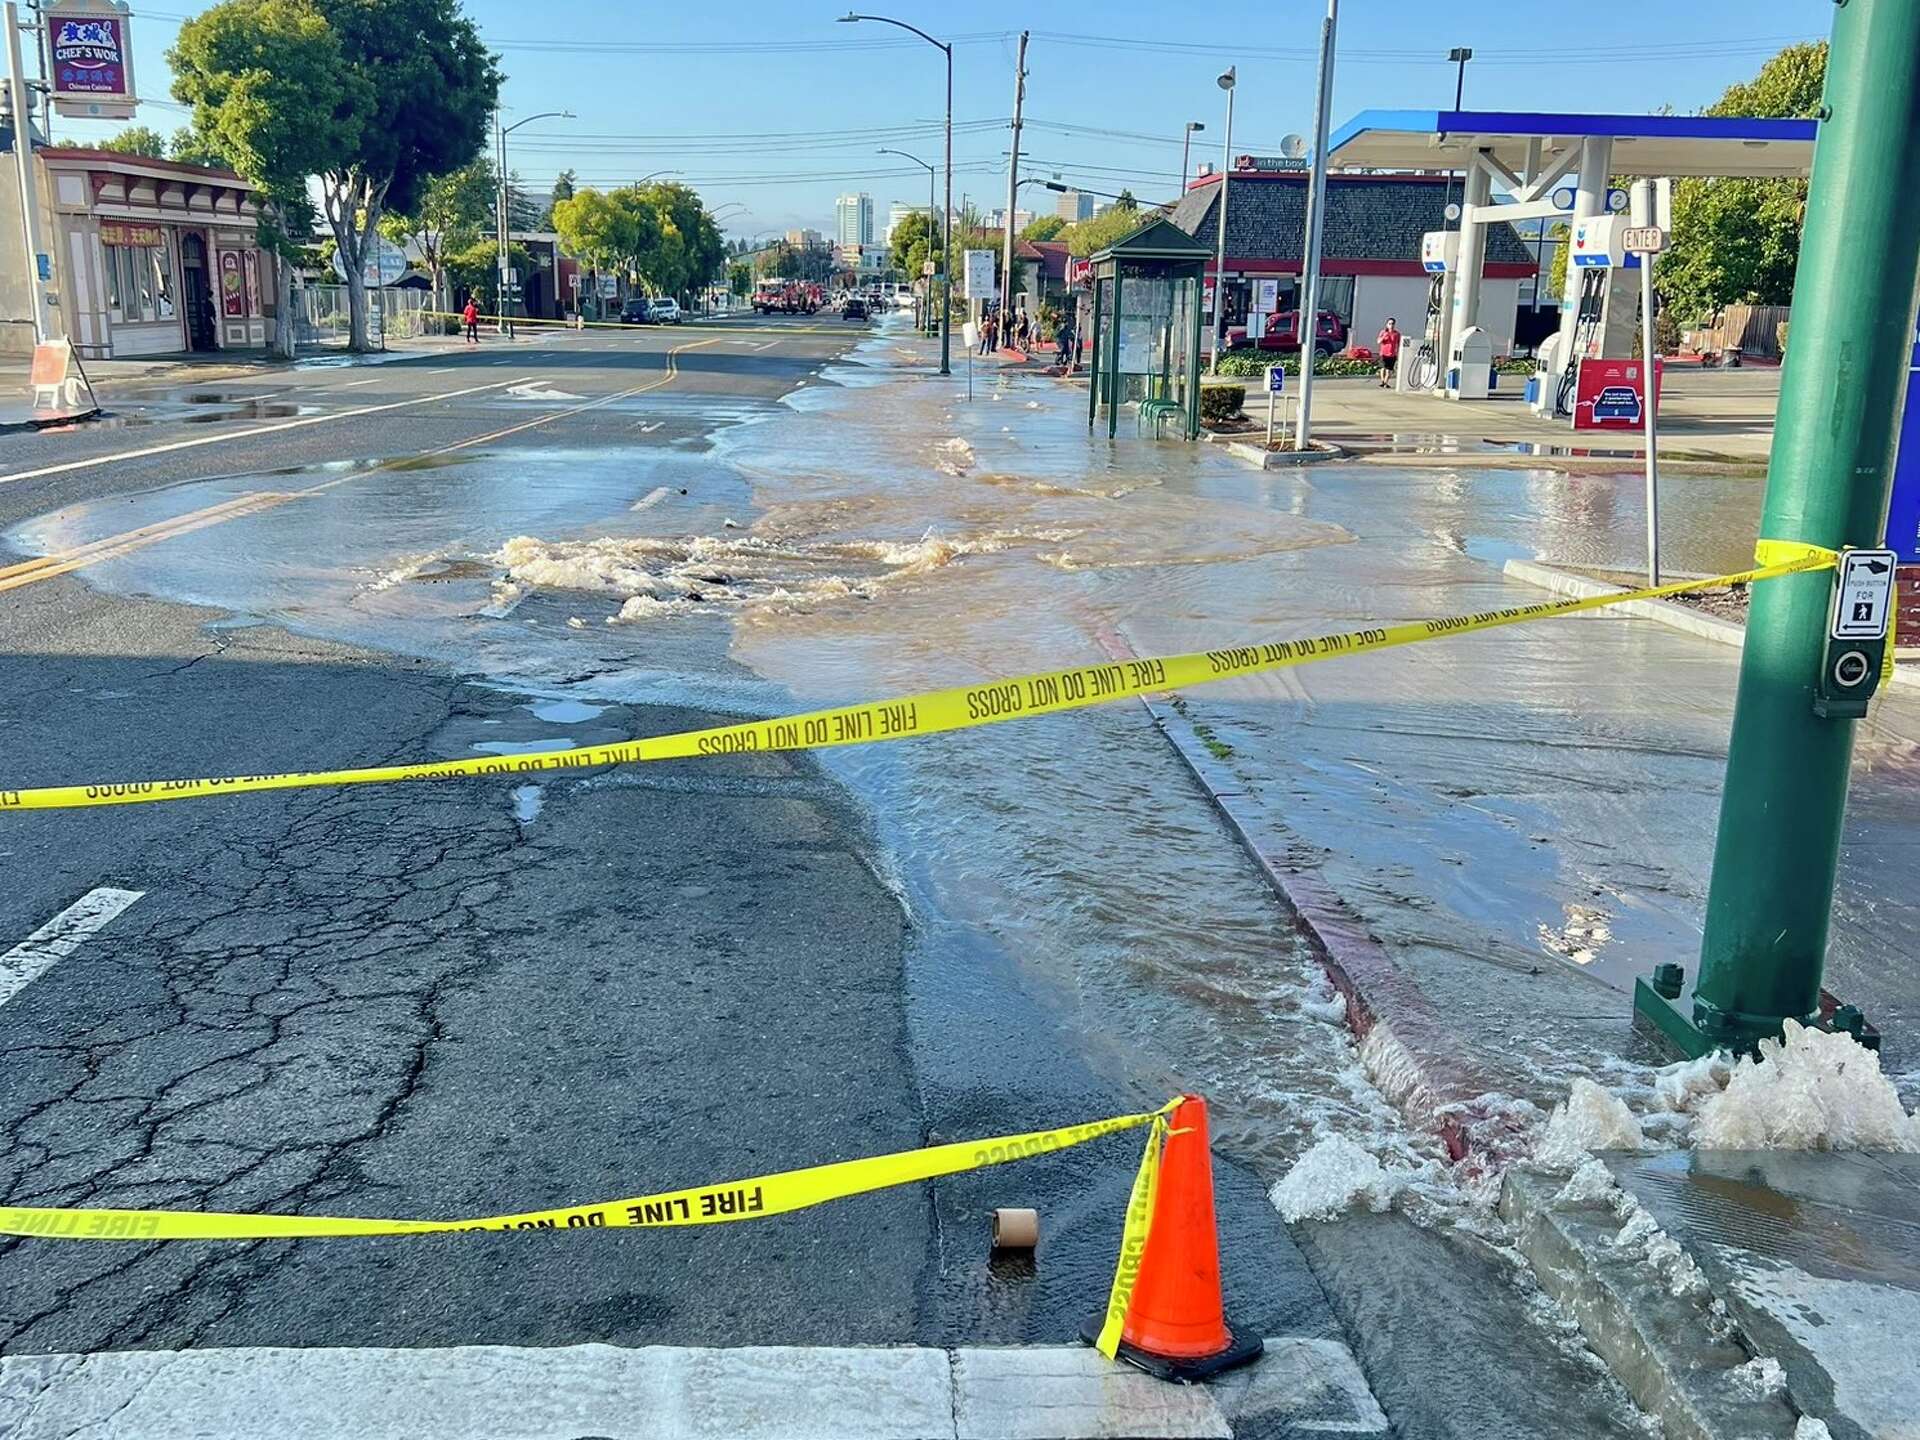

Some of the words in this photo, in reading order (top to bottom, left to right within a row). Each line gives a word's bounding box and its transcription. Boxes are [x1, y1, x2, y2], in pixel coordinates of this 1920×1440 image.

[56, 46, 92, 60] CHEF'S
[93, 48, 119, 62] WOK
[1614, 195, 1622, 205] 2
[1626, 230, 1658, 248] ENTER
[1856, 590, 1874, 600] FOR
[1206, 650, 1259, 673] CROSS
[1263, 642, 1293, 663] NOT
[1064, 672, 1086, 701] DO
[1088, 665, 1126, 697] LINE
[1127, 658, 1166, 689] FIRE
[967, 684, 1022, 719] CROSS
[1028, 678, 1059, 709] NOT
[804, 718, 828, 745] DO
[834, 711, 873, 741] LINE
[880, 702, 917, 734] FIRE
[698, 729, 758, 756] CROSS
[767, 723, 798, 749] NOT
[627, 1198, 690, 1226] LINE
[700, 1187, 764, 1217] FIRE
